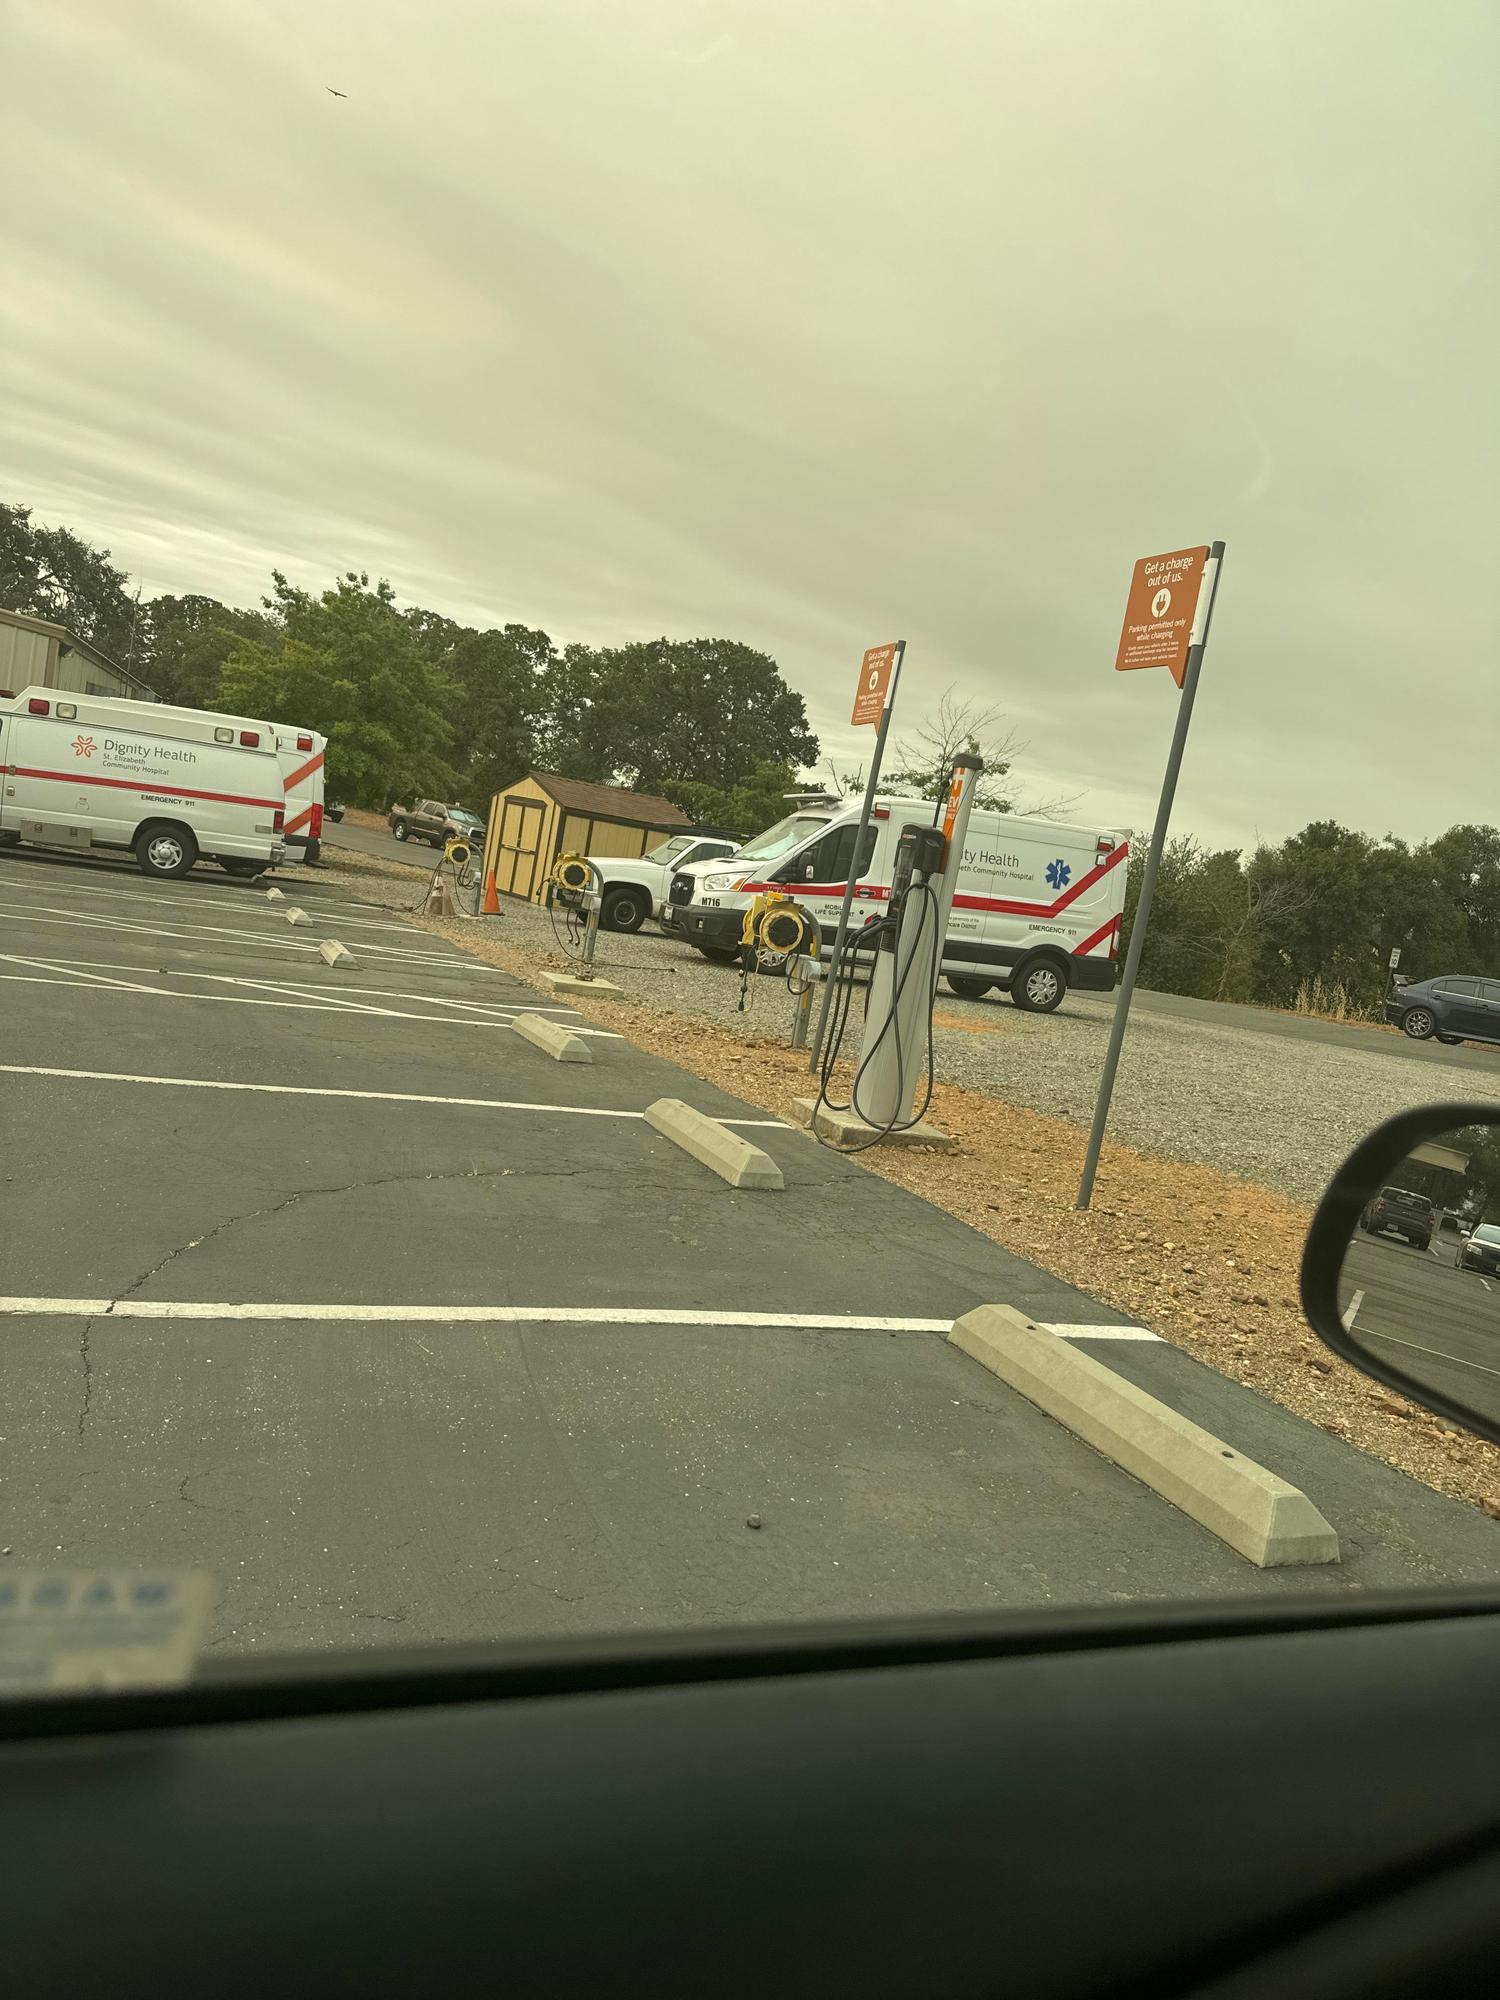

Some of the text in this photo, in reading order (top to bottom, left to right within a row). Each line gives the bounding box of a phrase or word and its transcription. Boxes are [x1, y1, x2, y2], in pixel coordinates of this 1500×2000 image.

[1144, 556, 1194, 574] Get a charge
[1147, 571, 1183, 587] out of us.
[1128, 617, 1186, 633] Parking permitted only
[1136, 630, 1174, 641] while charging
[104, 739, 196, 763] Dignity Health
[114, 755, 146, 765] Elizabeth
[102, 760, 169, 776] Community Hospital
[141, 794, 182, 805] EMERGENCY
[979, 850, 1019, 868] Health
[972, 866, 1008, 878] Community
[1009, 871, 1034, 881] Hospital
[701, 896, 721, 907] M716
[1028, 924, 1066, 934] EMERGENCY
